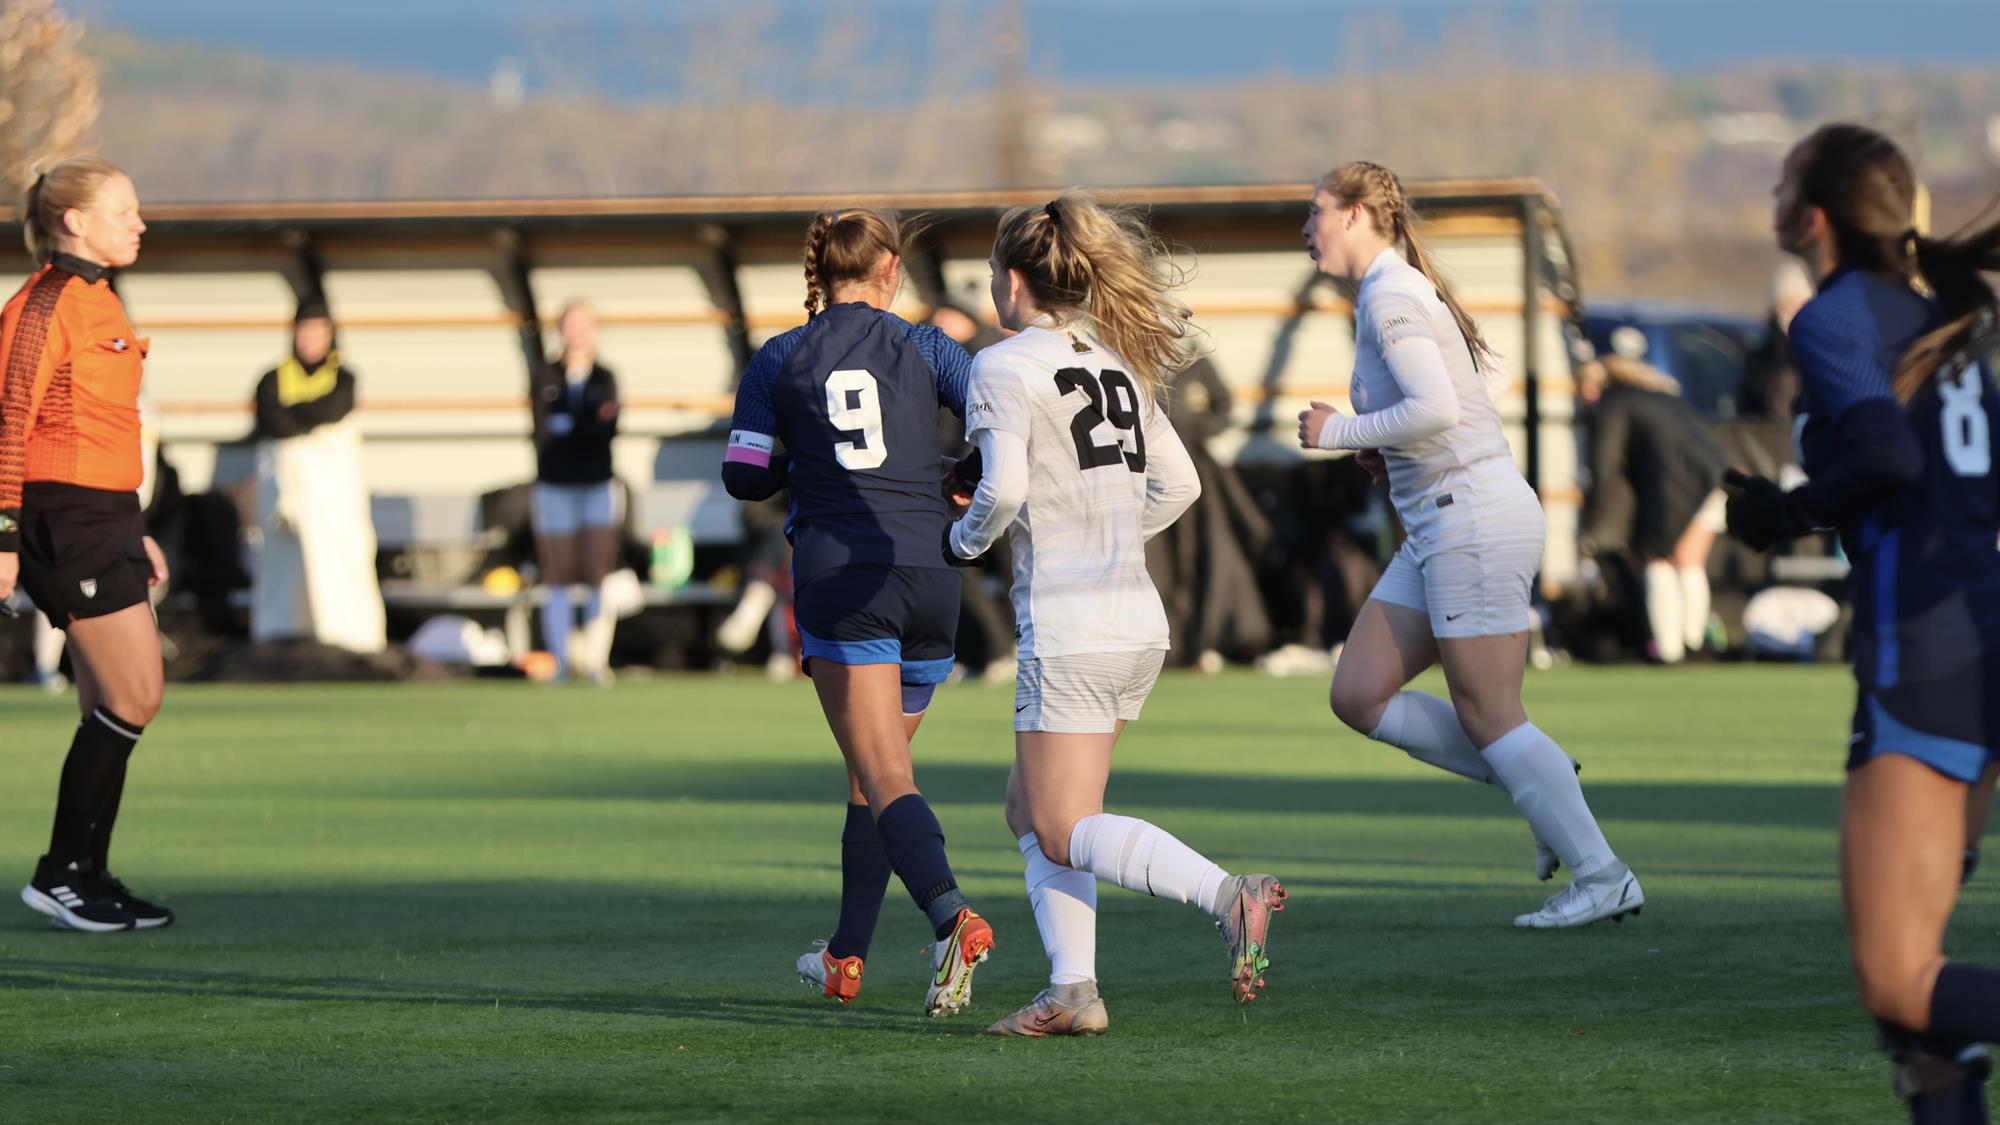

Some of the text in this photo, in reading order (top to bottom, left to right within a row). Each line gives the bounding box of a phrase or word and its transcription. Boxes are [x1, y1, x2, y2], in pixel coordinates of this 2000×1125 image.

[825, 369, 888, 470] 9
[1054, 367, 1146, 473] 29
[1937, 357, 1991, 477] 8
